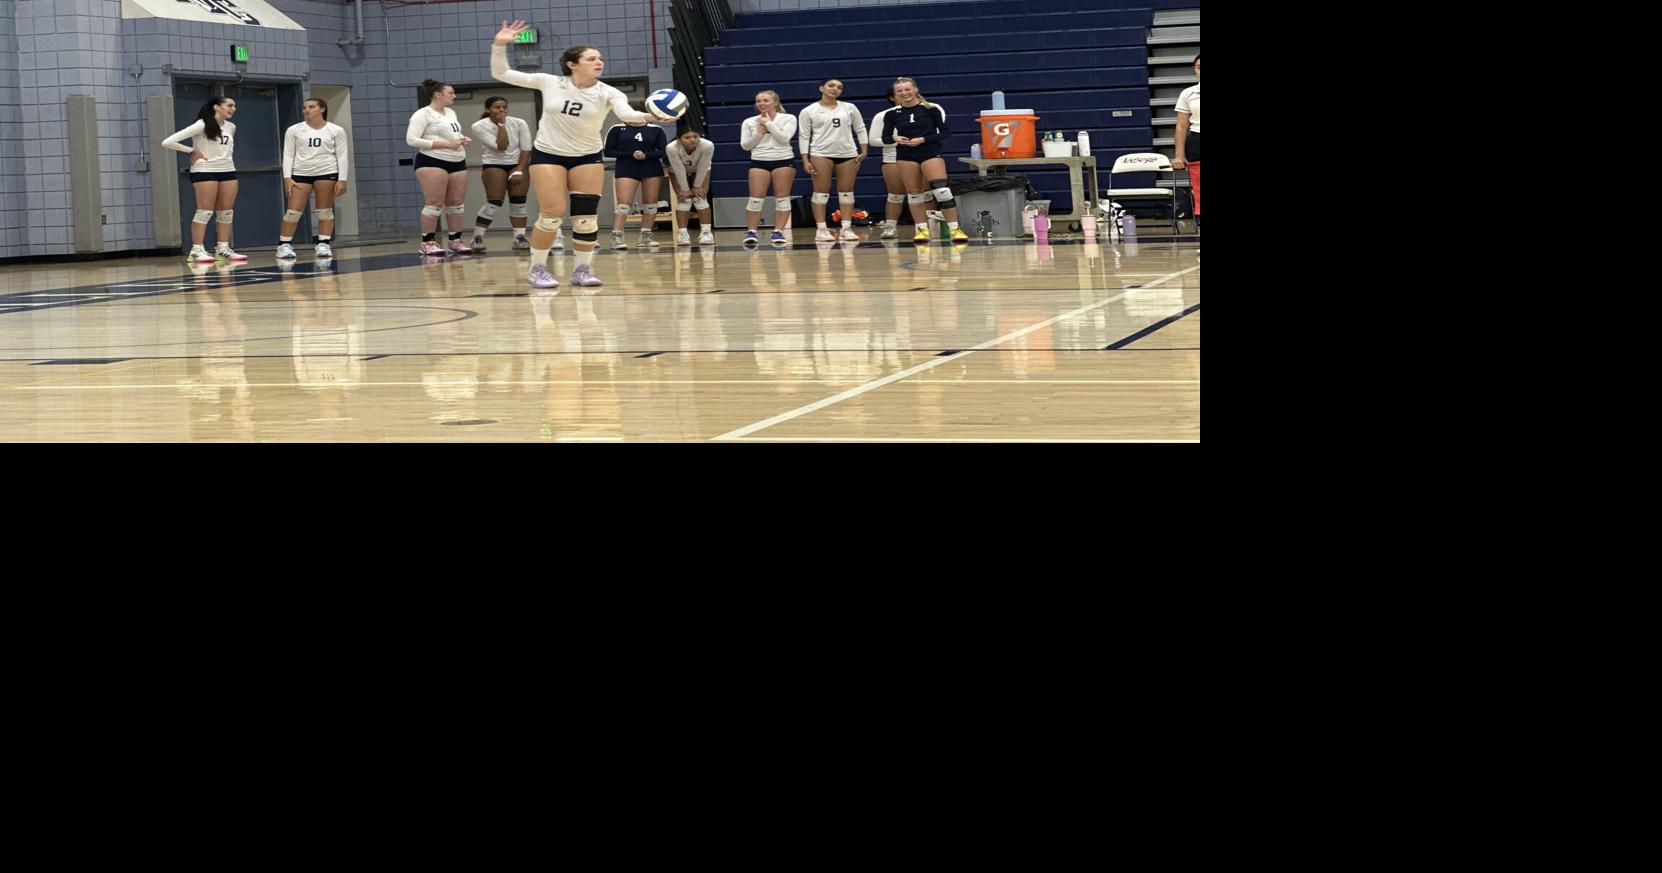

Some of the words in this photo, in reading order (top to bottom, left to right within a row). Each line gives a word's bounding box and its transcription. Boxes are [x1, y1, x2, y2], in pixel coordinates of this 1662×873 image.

[561, 100, 583, 117] 12
[832, 118, 841, 128] 9
[909, 113, 915, 123] 1
[451, 122, 459, 132] 11
[994, 122, 1010, 136] G
[220, 135, 230, 145] 17
[308, 137, 322, 147] 10
[634, 132, 643, 142] 4
